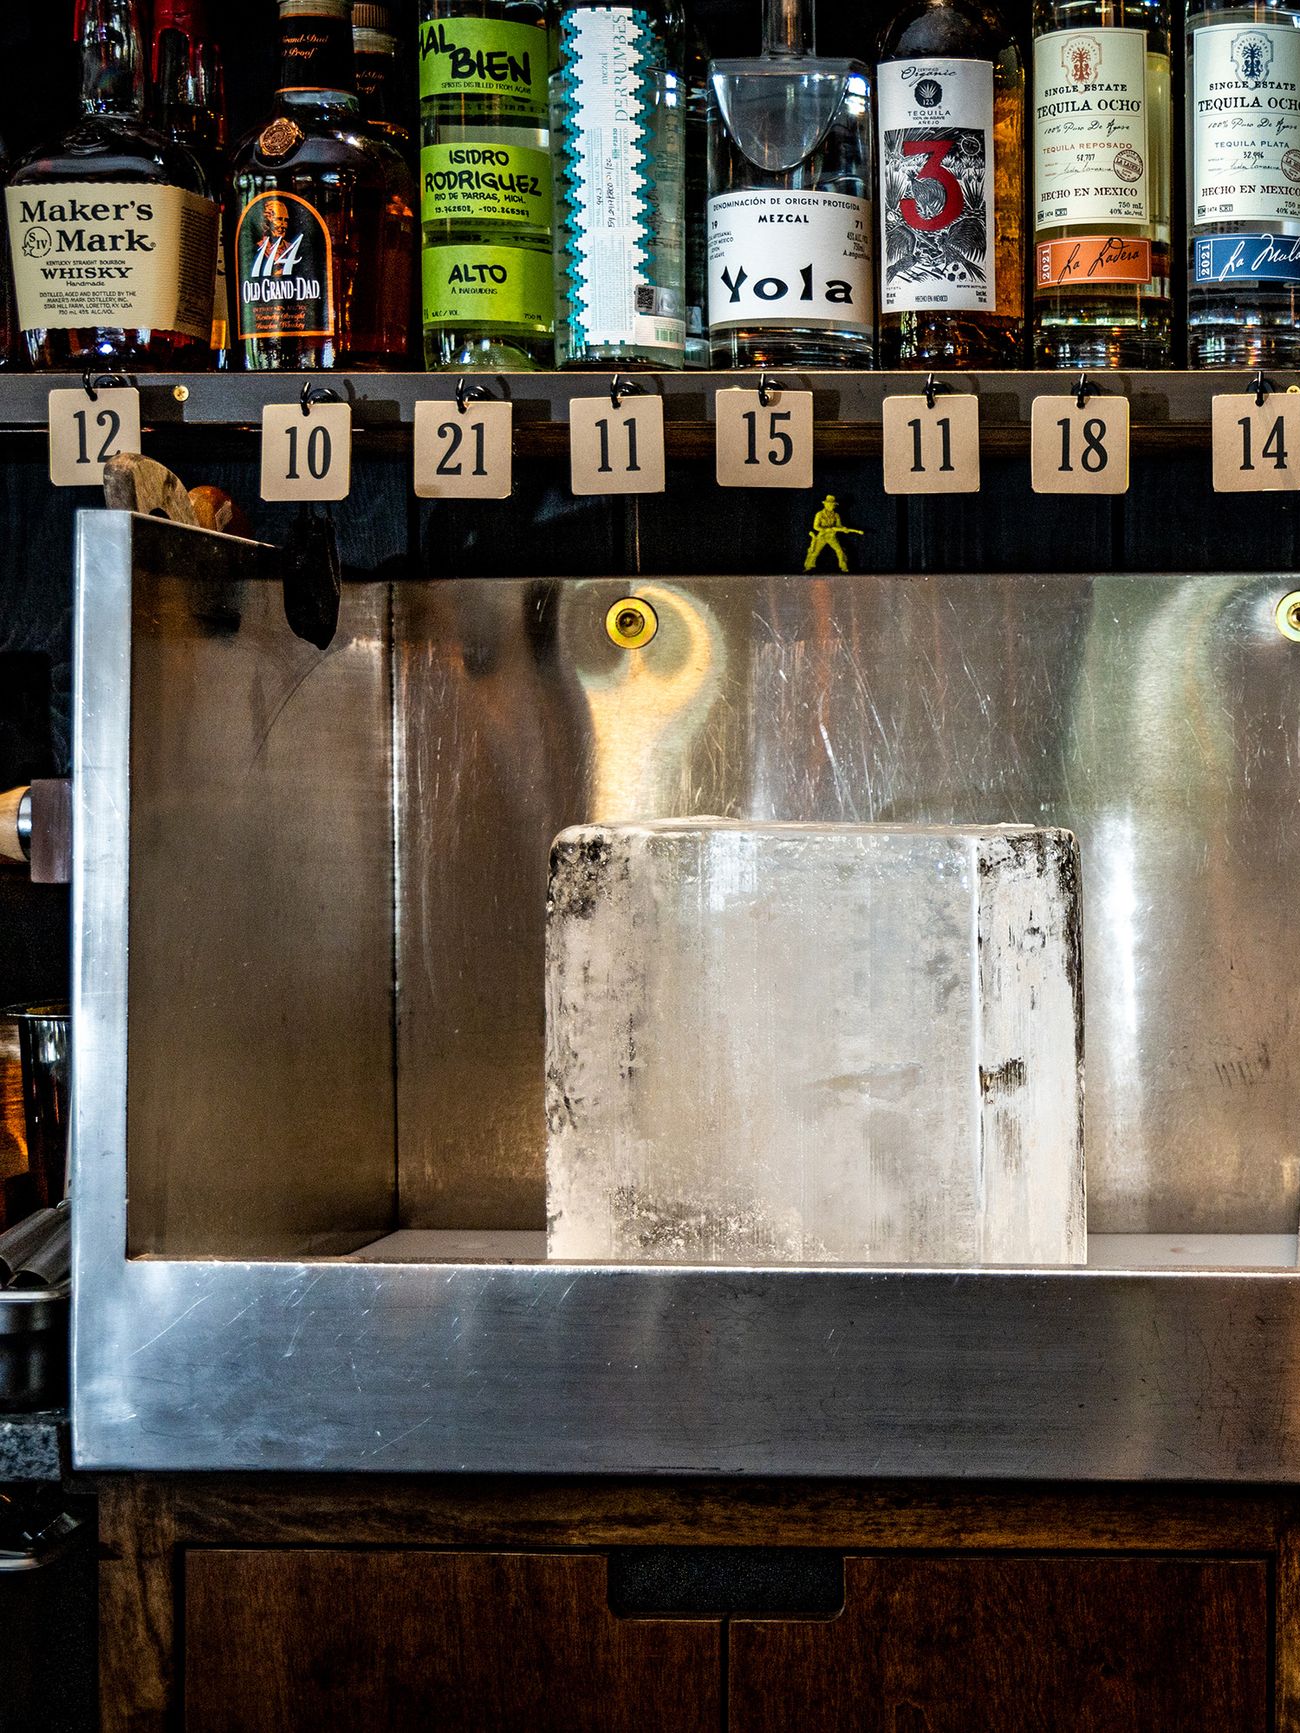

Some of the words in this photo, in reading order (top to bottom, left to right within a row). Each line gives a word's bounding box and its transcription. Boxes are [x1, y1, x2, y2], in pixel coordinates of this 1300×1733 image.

[449, 47, 532, 86] BIEN
[598, 53, 608, 84] mezcal
[613, 15, 628, 121] DERRUMBES
[901, 66, 957, 88] Organic
[464, 81, 494, 89] DISTILLED
[496, 83, 513, 91] FROM
[1044, 85, 1079, 97] SINGLE
[1084, 84, 1127, 92] ESTATE
[1209, 81, 1249, 91] SINGLE
[1255, 81, 1296, 91] ESTATE
[1037, 100, 1092, 119] TEQUILA
[1097, 99, 1140, 112] OCHO
[1198, 97, 1263, 112] TEQUILA
[449, 150, 509, 166] ISIDRO
[1042, 144, 1075, 154] TEQUILA
[1079, 142, 1133, 150] REPOSADO
[425, 170, 542, 197] RODRIGUEZ
[899, 139, 966, 232] 3
[1041, 189, 1071, 202] HECHO
[1074, 188, 1090, 196] EN
[1094, 187, 1138, 197] MEXICO
[1202, 186, 1235, 197] HECHO
[1240, 185, 1256, 193] EN
[20, 199, 153, 223] Maker's
[435, 193, 446, 201] RIO
[449, 192, 458, 200] DE
[461, 192, 500, 203] PARRAS,
[504, 195, 526, 204] MICH.
[713, 197, 766, 212] DENOMINACIÓN
[785, 198, 819, 206] ORIGEN
[823, 200, 860, 211] PROTEGIDA
[1118, 201, 1131, 209] 750
[758, 214, 809, 223] MEZCAL
[855, 220, 863, 230] 71
[55, 229, 154, 252] Mark
[251, 233, 304, 277] 114
[1042, 249, 1050, 280] 2021
[1057, 243, 1081, 284] La
[1087, 237, 1141, 277] Ladera
[1201, 243, 1210, 276] 2021
[1219, 240, 1245, 281] La
[40, 267, 133, 280] WHISKY
[448, 264, 507, 285] ALTO
[720, 263, 854, 304] Yola
[243, 280, 261, 304] OLD
[262, 277, 319, 302] GRAND-DAD
[73, 409, 121, 464] 12
[436, 422, 488, 476] 21
[594, 417, 642, 473] 11
[741, 410, 794, 466] 15
[907, 417, 955, 472] 11
[1057, 417, 1109, 473] 18
[1237, 415, 1288, 471] 14
[284, 425, 332, 480] 10
